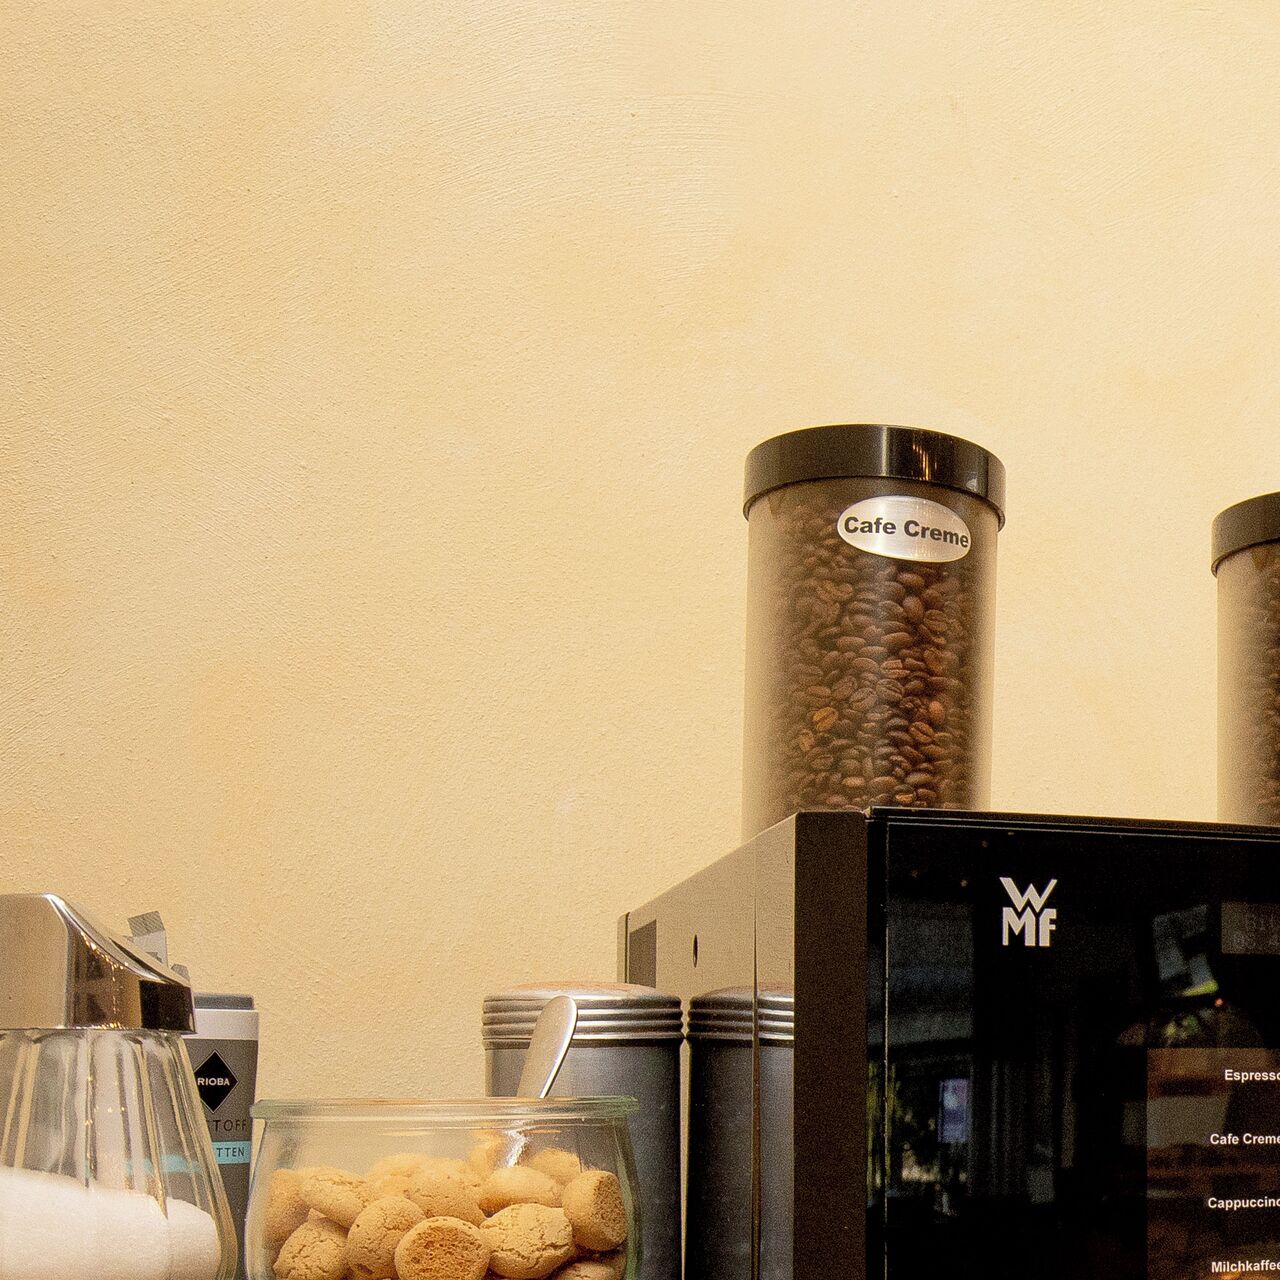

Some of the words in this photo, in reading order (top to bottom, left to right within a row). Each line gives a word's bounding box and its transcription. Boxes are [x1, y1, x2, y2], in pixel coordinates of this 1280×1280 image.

[844, 516, 896, 534] Cafe
[903, 519, 969, 548] Creme
[999, 876, 1058, 947] WMF
[197, 1077, 231, 1087] RIOBA
[1210, 1132, 1240, 1145] Cafe
